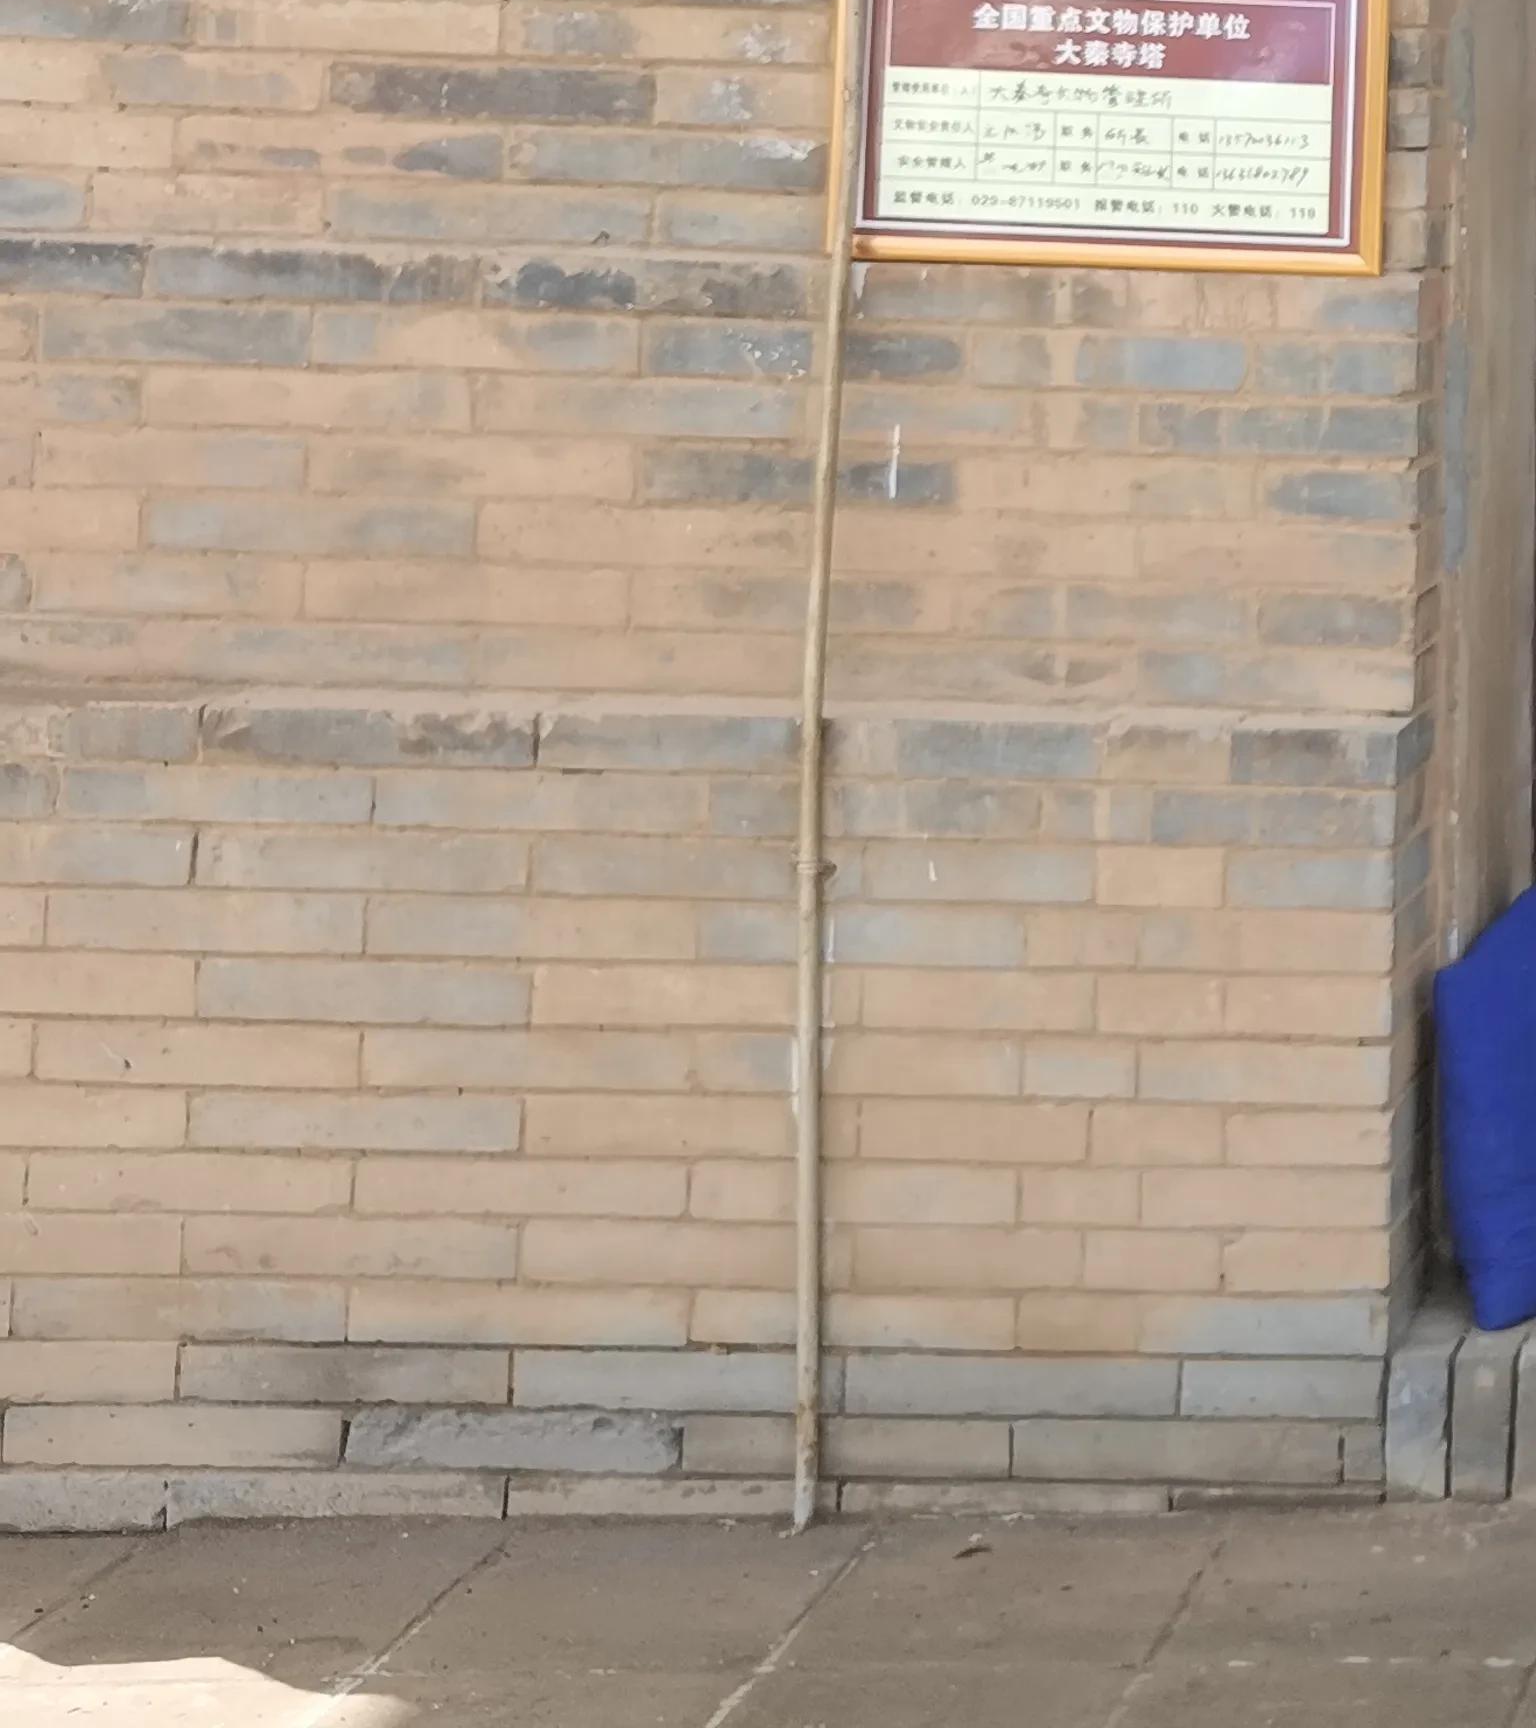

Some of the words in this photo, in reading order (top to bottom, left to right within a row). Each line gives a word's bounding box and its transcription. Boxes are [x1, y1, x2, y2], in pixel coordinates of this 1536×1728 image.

[971, 2, 1252, 41] 全国重点文物保护单位
[1053, 38, 1168, 70] 大秦寺塔
